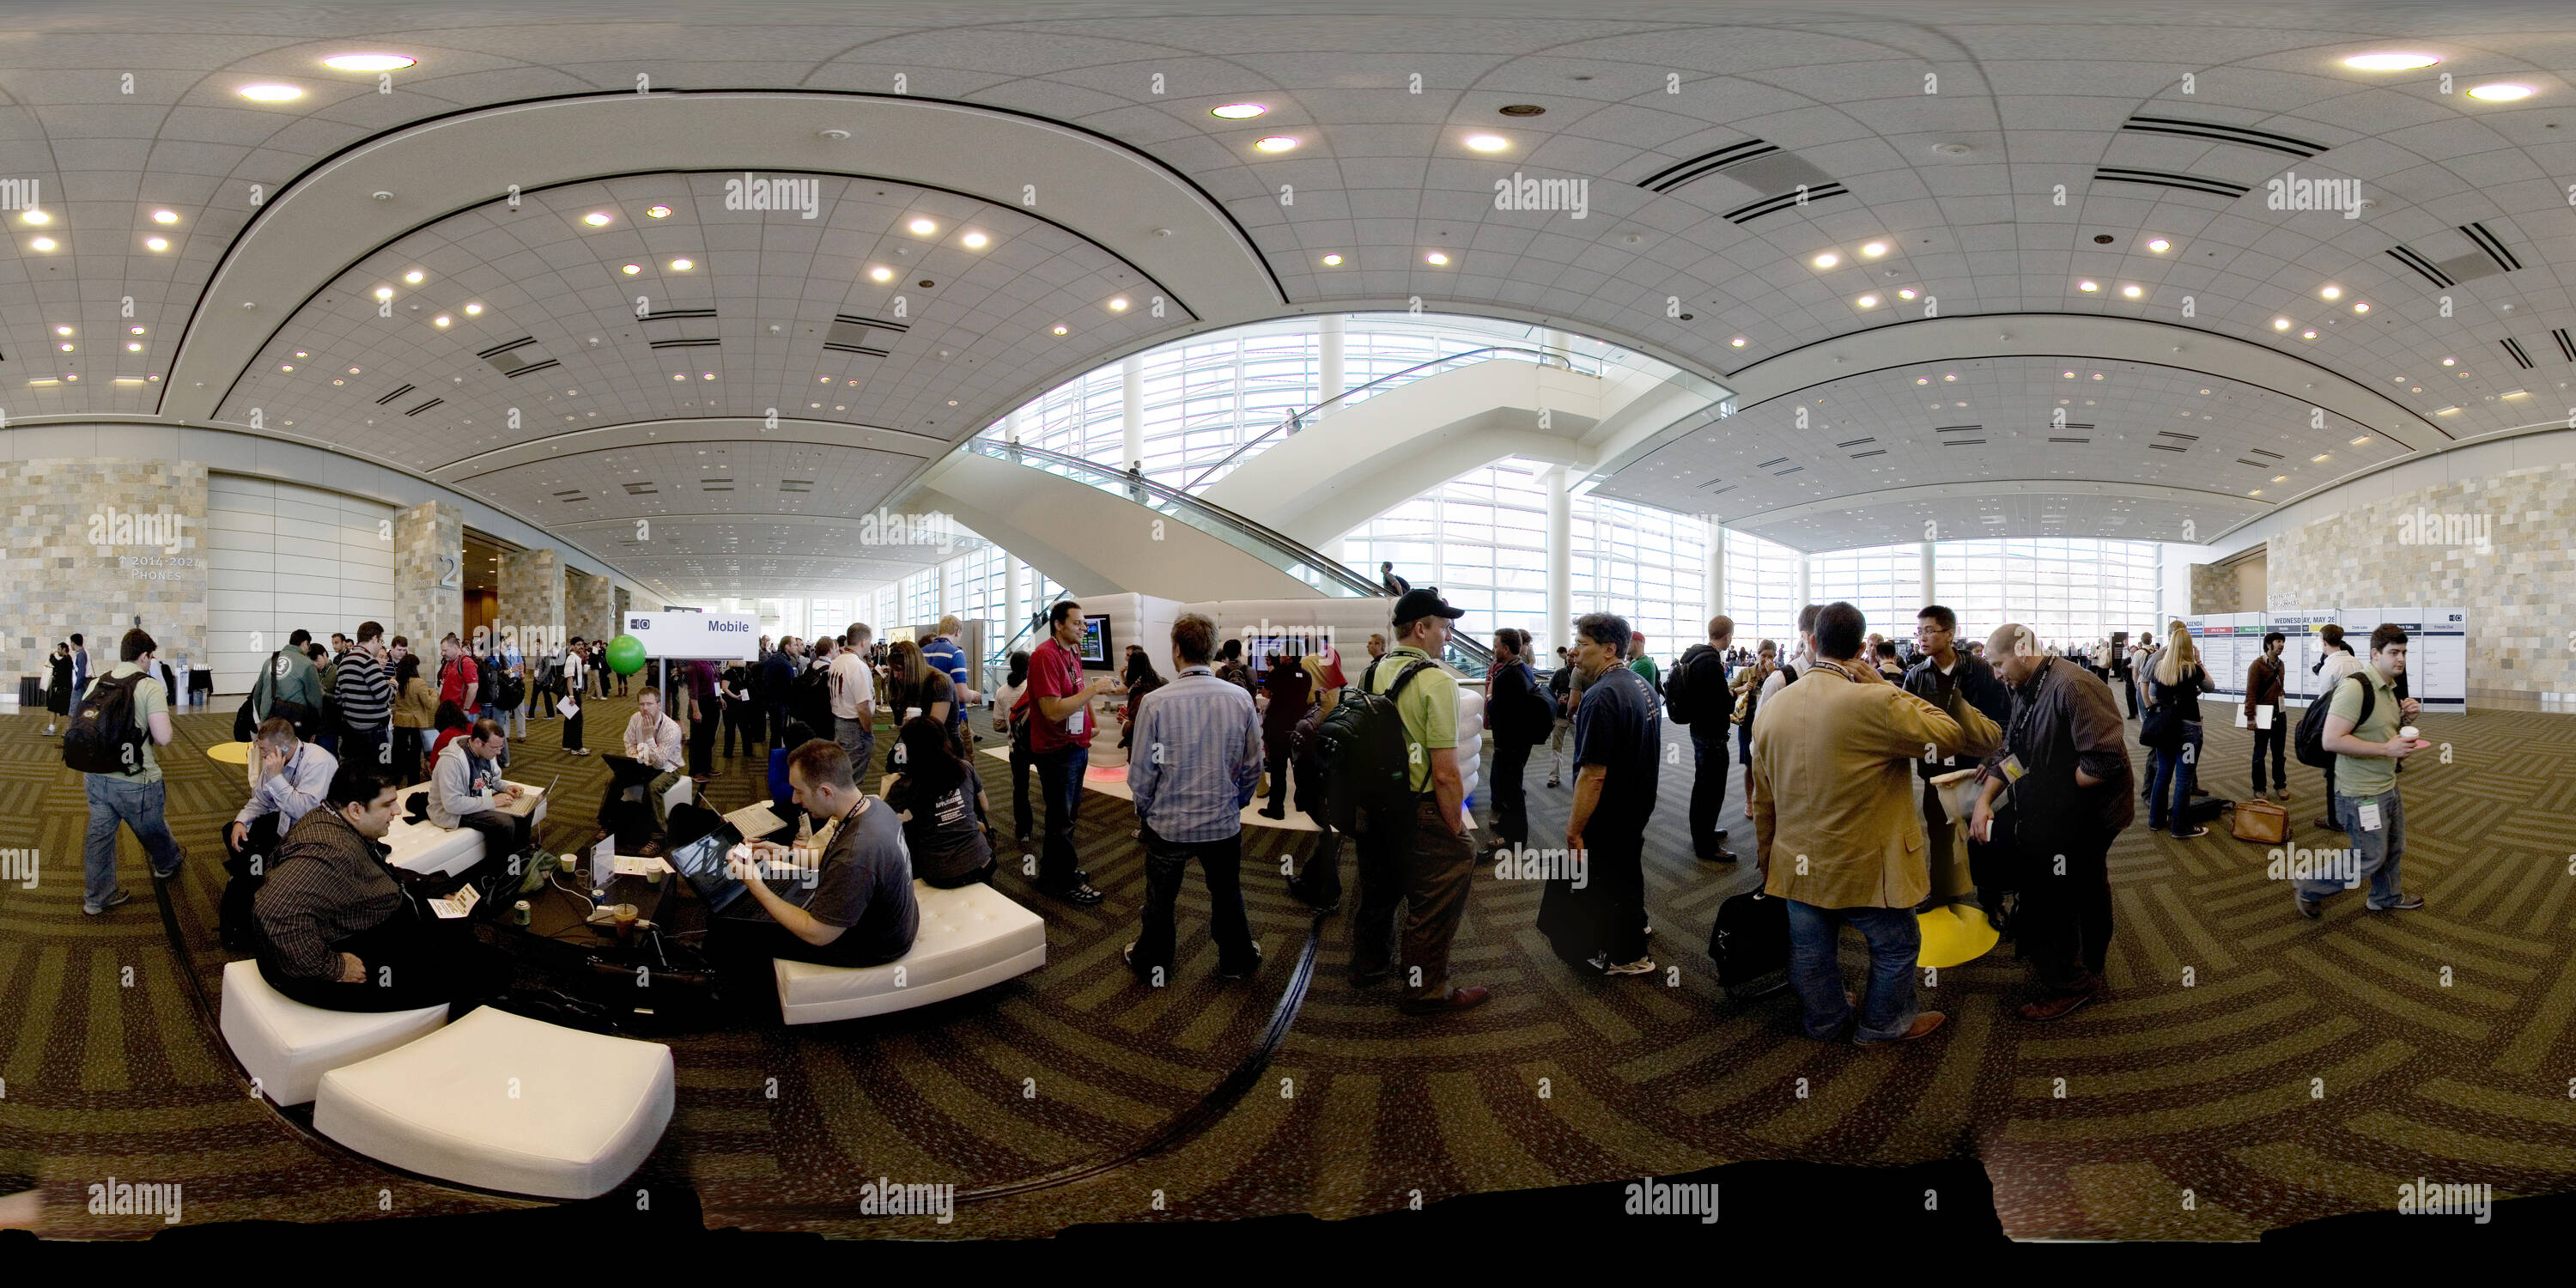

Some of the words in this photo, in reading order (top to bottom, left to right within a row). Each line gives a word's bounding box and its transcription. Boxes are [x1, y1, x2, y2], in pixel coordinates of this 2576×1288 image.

[440, 556, 458, 587] 2
[610, 601, 617, 619] 2
[708, 620, 750, 633] Mobile
